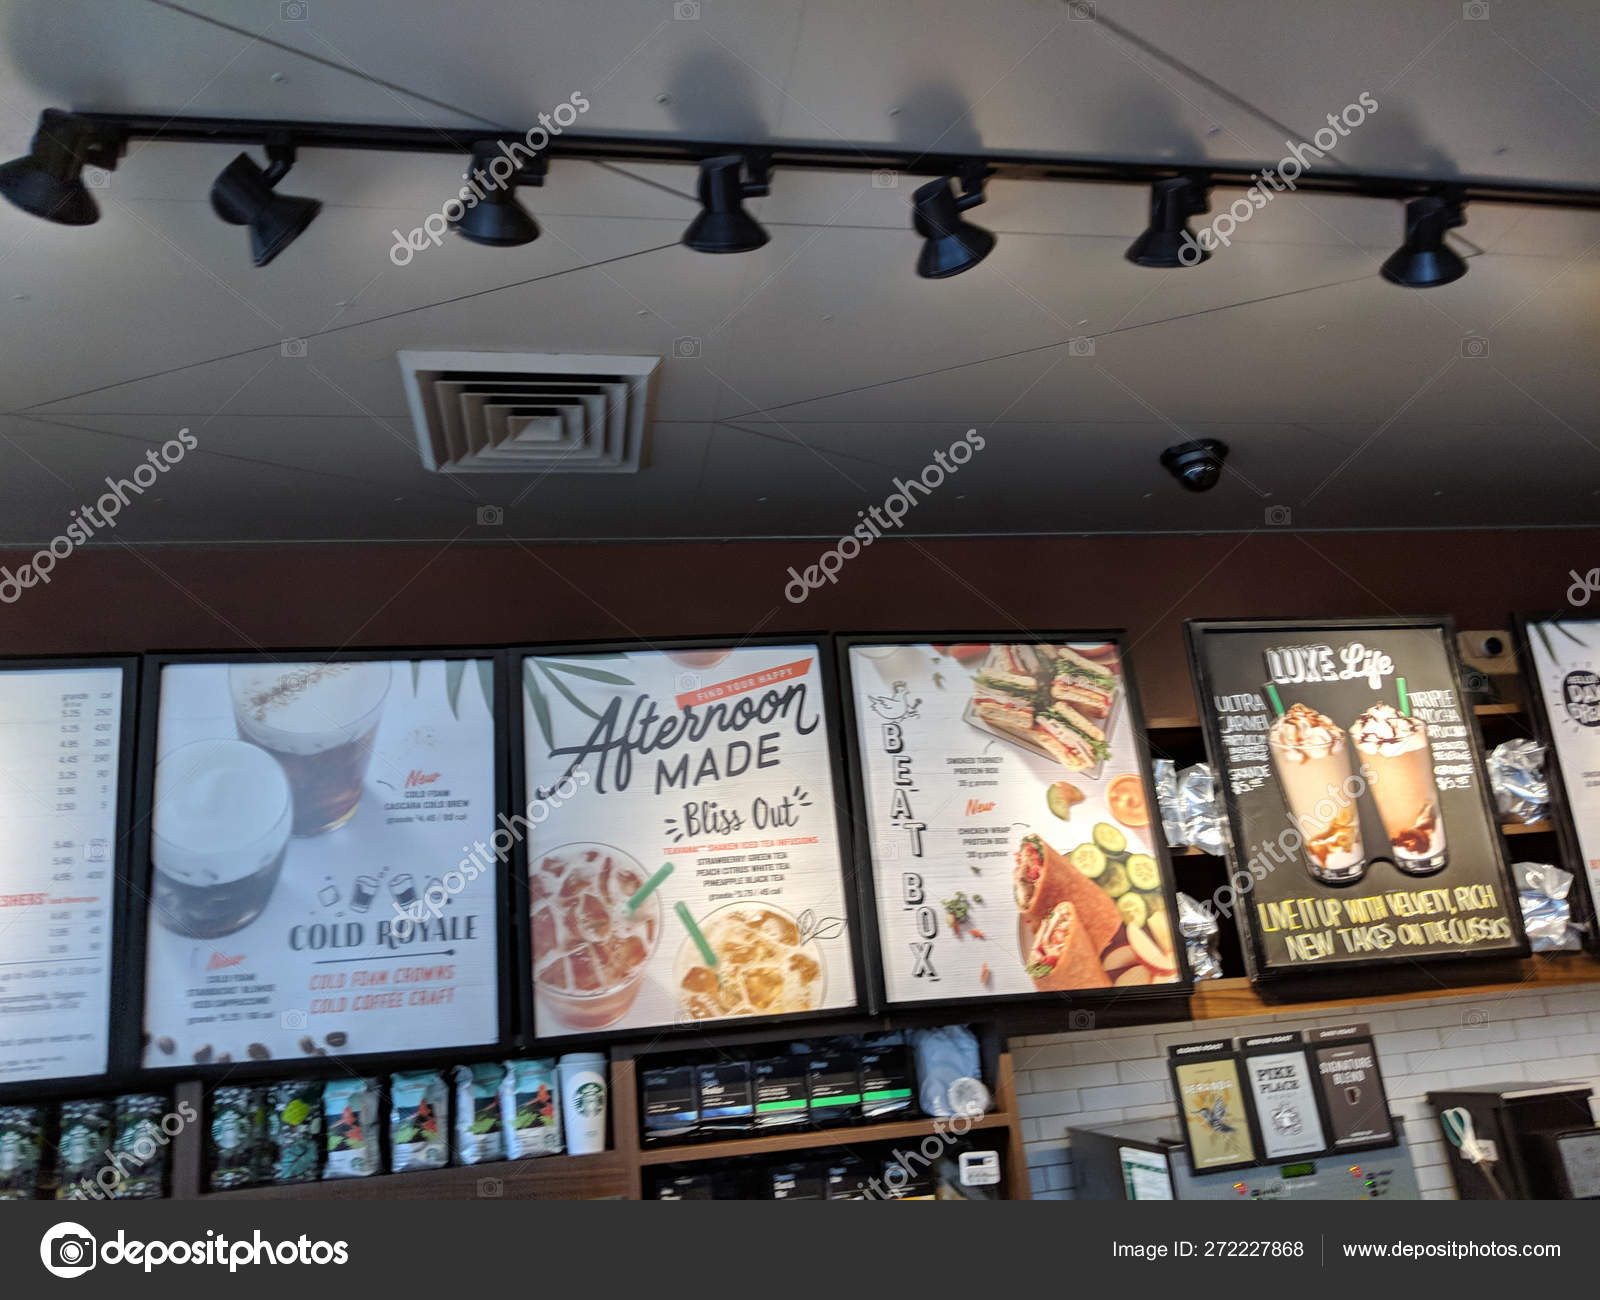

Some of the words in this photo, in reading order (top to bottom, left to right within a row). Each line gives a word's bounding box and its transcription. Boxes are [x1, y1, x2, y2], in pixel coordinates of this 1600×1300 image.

[1264, 644, 1340, 684] LUXE
[1340, 641, 1395, 690] Life
[696, 687, 723, 701] FIND
[726, 679, 755, 693] YOUR
[758, 667, 793, 684] HAPPY
[1213, 693, 1267, 712] ULTRA
[1406, 689, 1457, 708] TRIPLE
[536, 683, 820, 800] Afternoon
[656, 732, 781, 796] MADE
[953, 767, 984, 775] PROTEIN
[404, 769, 442, 790] New
[881, 722, 926, 857] BEAT
[446, 799, 470, 808] BREW
[965, 798, 997, 817] New
[683, 801, 745, 838] Bliss
[752, 796, 799, 830] Out
[991, 826, 1011, 834] WRAP
[994, 837, 1009, 845] BOX
[696, 855, 747, 866] STRAWBERRY
[747, 852, 772, 862] GREEN
[773, 851, 788, 860] TEA
[696, 868, 721, 877] PEACH
[721, 866, 750, 875] CITRUS
[751, 864, 775, 873] WHITE
[776, 862, 791, 870] TEA
[703, 877, 744, 888] PINEAPPLE
[744, 875, 769, 885] BLACK
[770, 873, 785, 882] TEA
[1257, 898, 1303, 932] LIVE
[1297, 897, 1320, 931] IT
[1317, 898, 1344, 929] UP
[1343, 894, 1390, 925] WITH
[1453, 884, 1498, 912] RICH
[289, 922, 364, 951] COLD
[376, 915, 479, 950] ROYALE
[901, 871, 939, 979] BOX
[1285, 929, 1336, 962] NEW
[1336, 922, 1397, 954] TAKES
[1397, 922, 1427, 946] ON
[1419, 919, 1450, 945] THE
[1447, 915, 1512, 945] CLASSICS
[309, 972, 347, 991] COLD
[351, 970, 389, 987] FOAM
[393, 965, 456, 984] CROWNS
[310, 997, 348, 1014] COLD
[352, 991, 404, 1012] COFFEE
[408, 987, 456, 1006] CRAFT
[1257, 1065, 1296, 1082] PIKE
[1319, 1056, 1375, 1075] SIGNATURE
[1259, 1080, 1301, 1094] PLACE
[1332, 1070, 1366, 1086] BLEND
